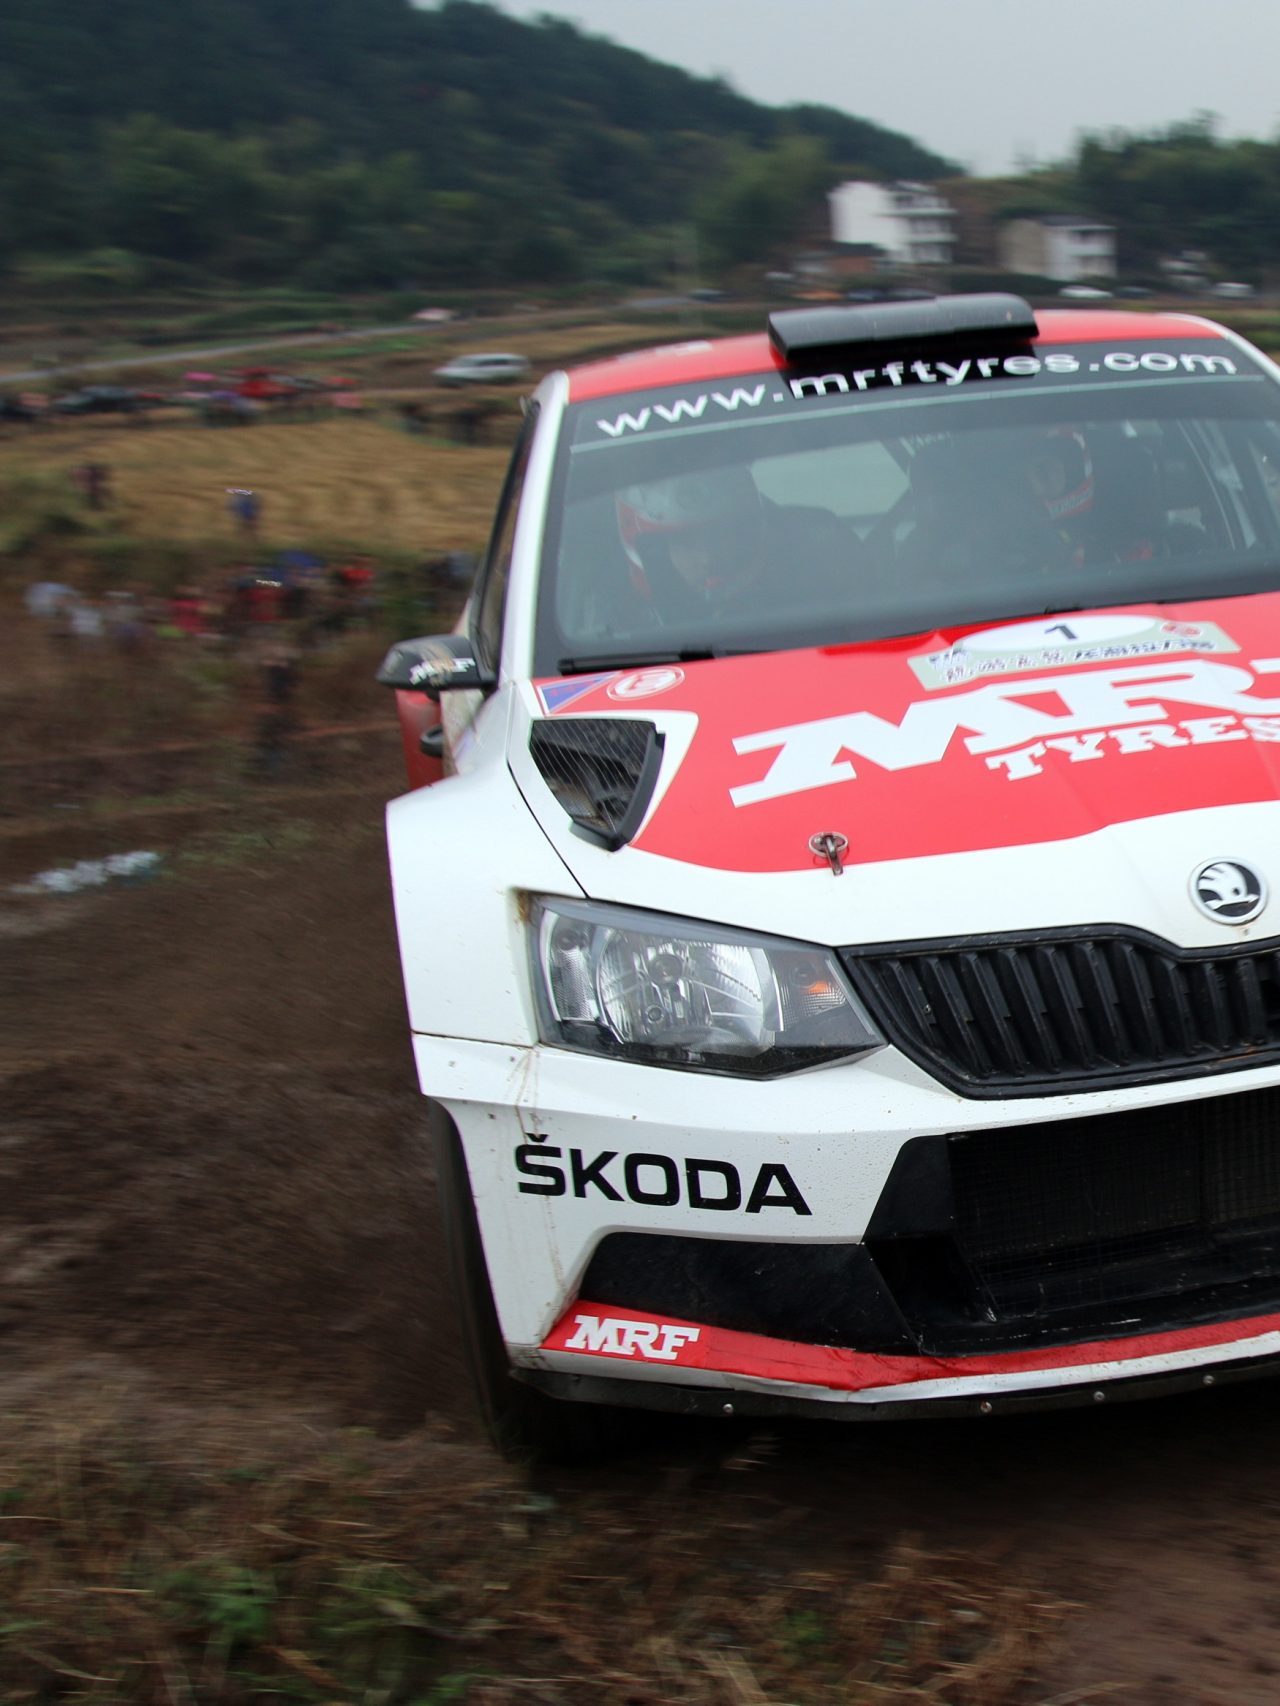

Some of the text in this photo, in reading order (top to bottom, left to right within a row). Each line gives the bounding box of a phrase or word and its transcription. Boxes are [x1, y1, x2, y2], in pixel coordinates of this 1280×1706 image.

[597, 351, 1237, 436] www.mrftyres.com
[1044, 624, 1077, 640] 1
[514, 1133, 812, 1216] ŠKODA
[565, 1315, 699, 1360] MRF
